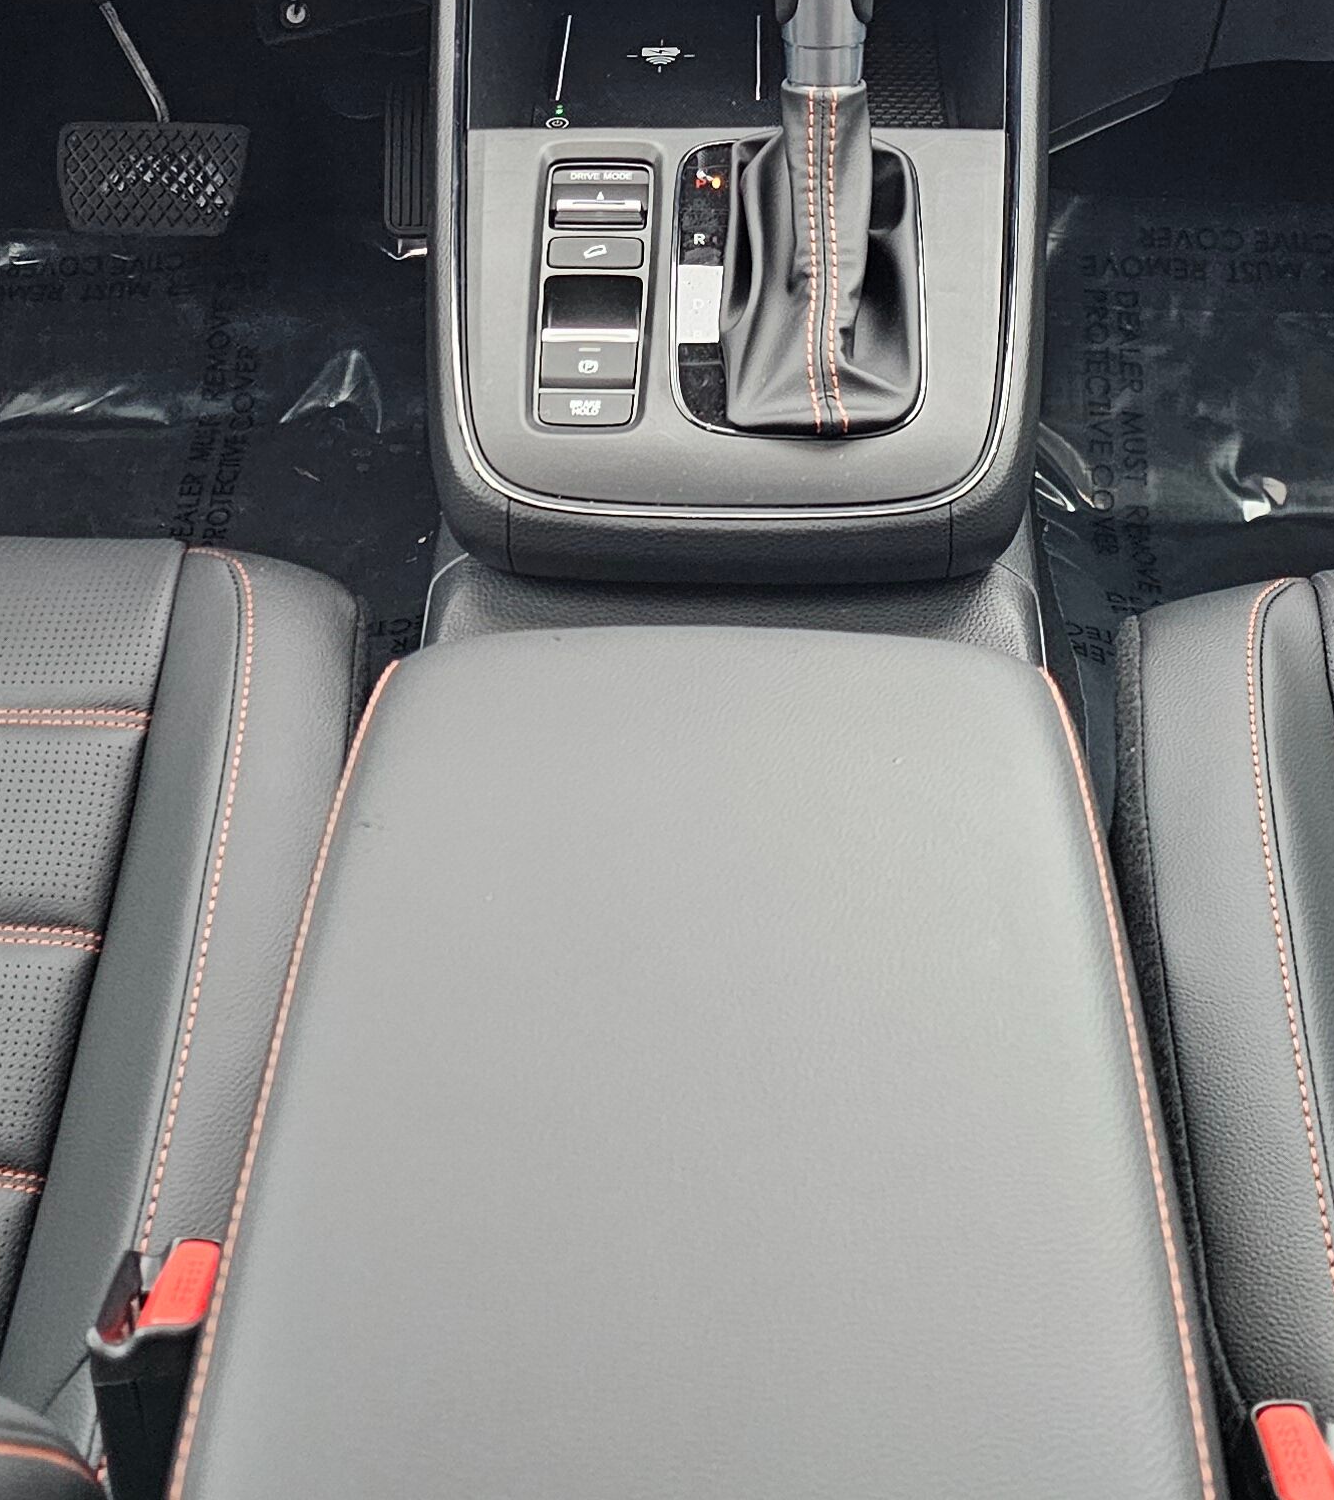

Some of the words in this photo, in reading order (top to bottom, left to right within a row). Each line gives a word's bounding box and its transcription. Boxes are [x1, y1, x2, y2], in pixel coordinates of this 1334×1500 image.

[570, 172, 601, 181] DRIVE
[603, 172, 633, 181] MODE
[693, 233, 706, 245] R
[1139, 226, 1245, 254] COVER
[1082, 254, 1208, 283] REMOVE
[1228, 258, 1302, 284] MUST
[1116, 291, 1145, 393] DEALER
[1083, 288, 1115, 457] PROTECTIVE
[229, 345, 261, 431] COVER
[570, 400, 601, 409] BRAKE
[571, 408, 600, 416] HOLD
[1121, 411, 1148, 485] MUST
